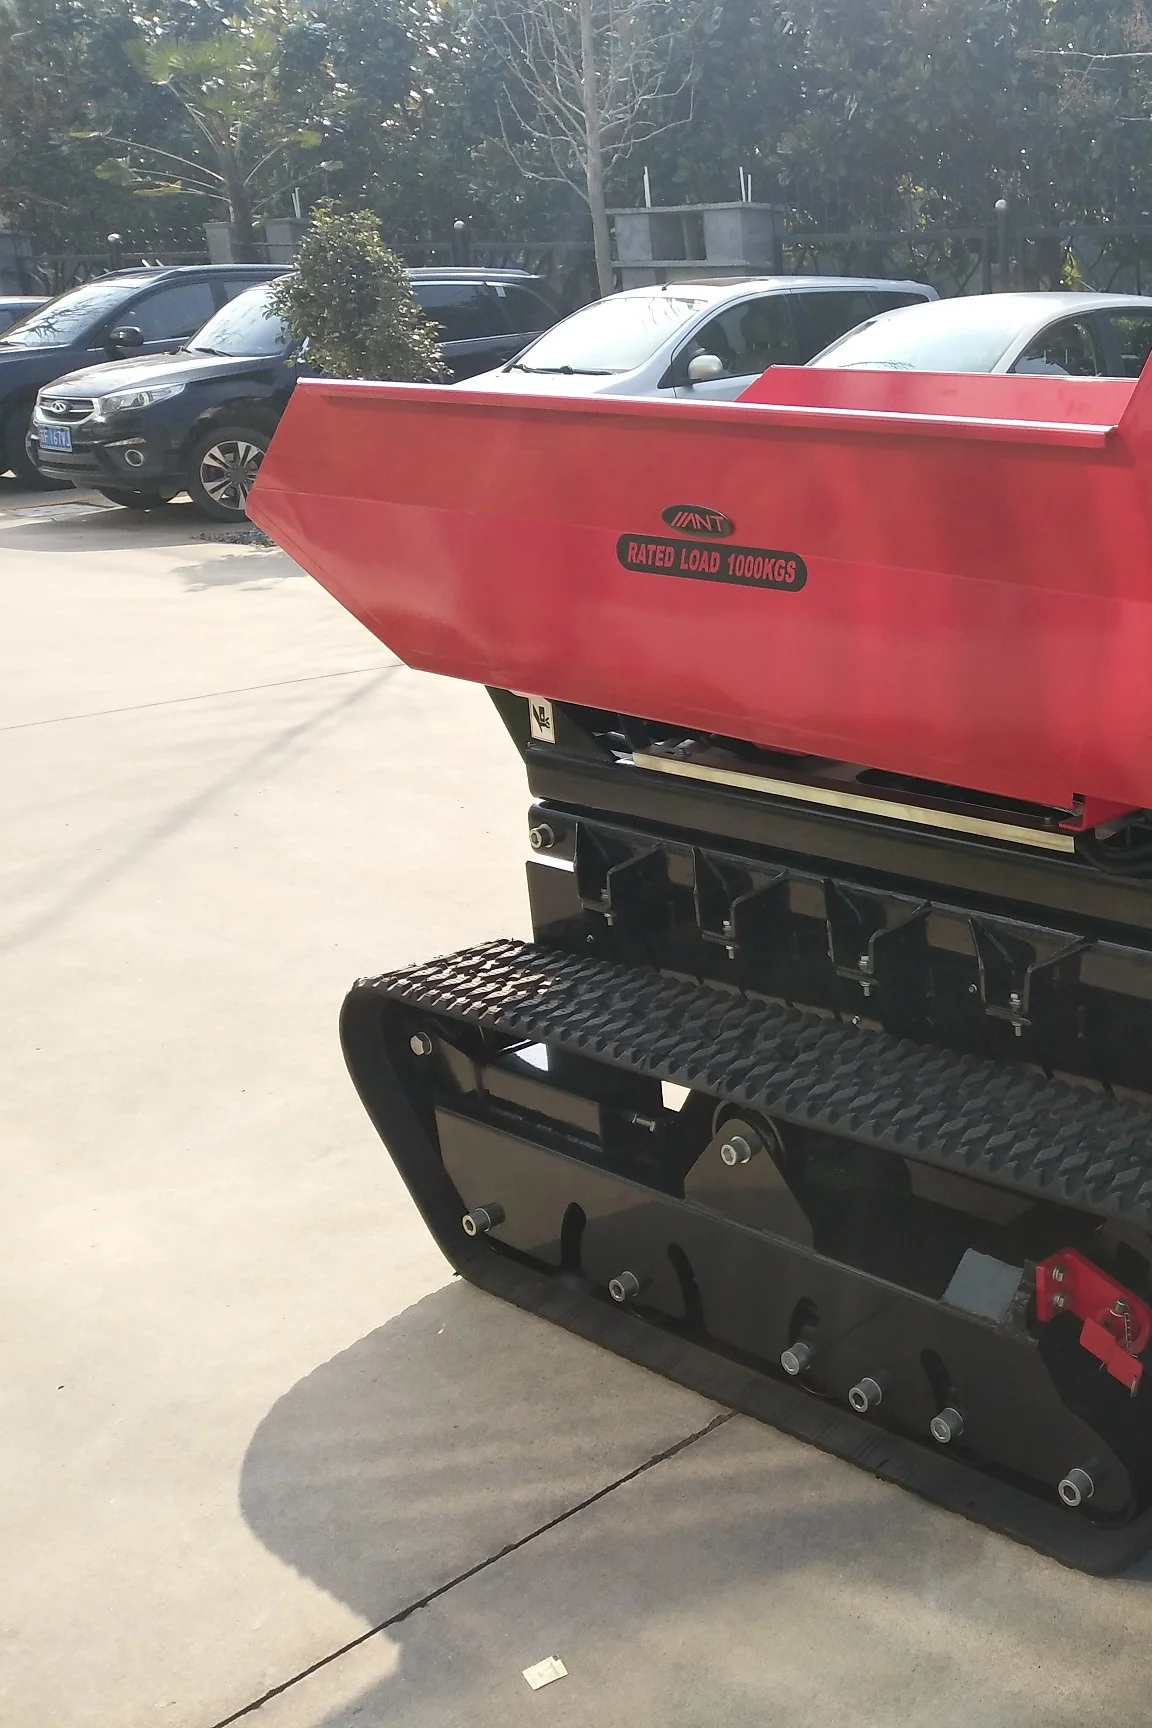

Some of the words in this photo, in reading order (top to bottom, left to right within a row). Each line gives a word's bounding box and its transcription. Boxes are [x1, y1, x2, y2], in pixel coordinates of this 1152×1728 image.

[627, 542, 675, 568] RATED
[680, 548, 720, 574] LOAD
[727, 553, 796, 583] 1000KGS
